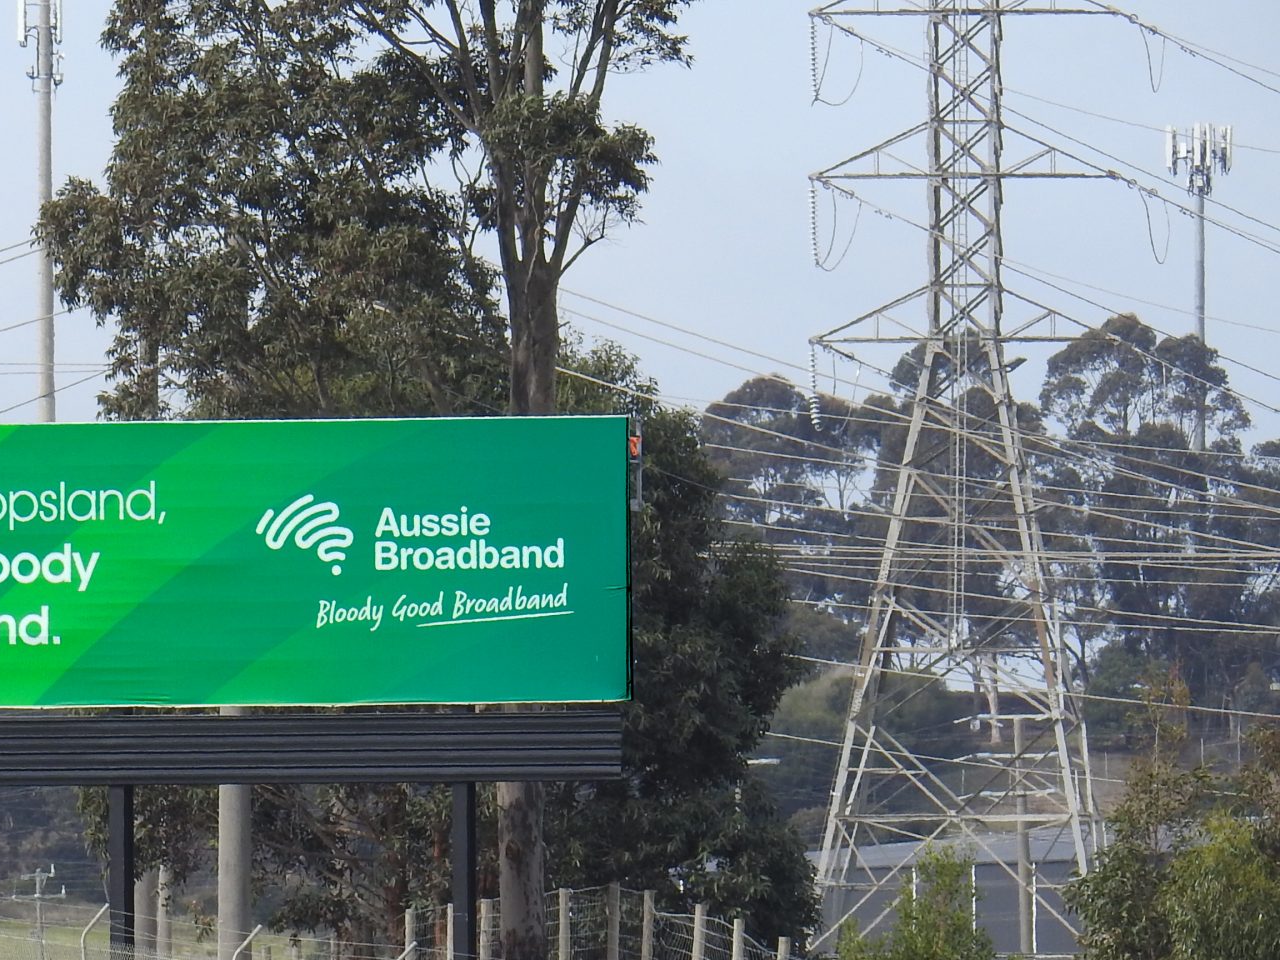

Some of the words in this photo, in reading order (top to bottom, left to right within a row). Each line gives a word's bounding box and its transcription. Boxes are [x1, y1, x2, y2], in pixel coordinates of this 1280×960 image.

[375, 506, 491, 537] Aussie
[375, 538, 565, 571] Broadband
[316, 596, 384, 632] Bloody
[392, 591, 444, 622] Good
[452, 582, 568, 619] Broadband
